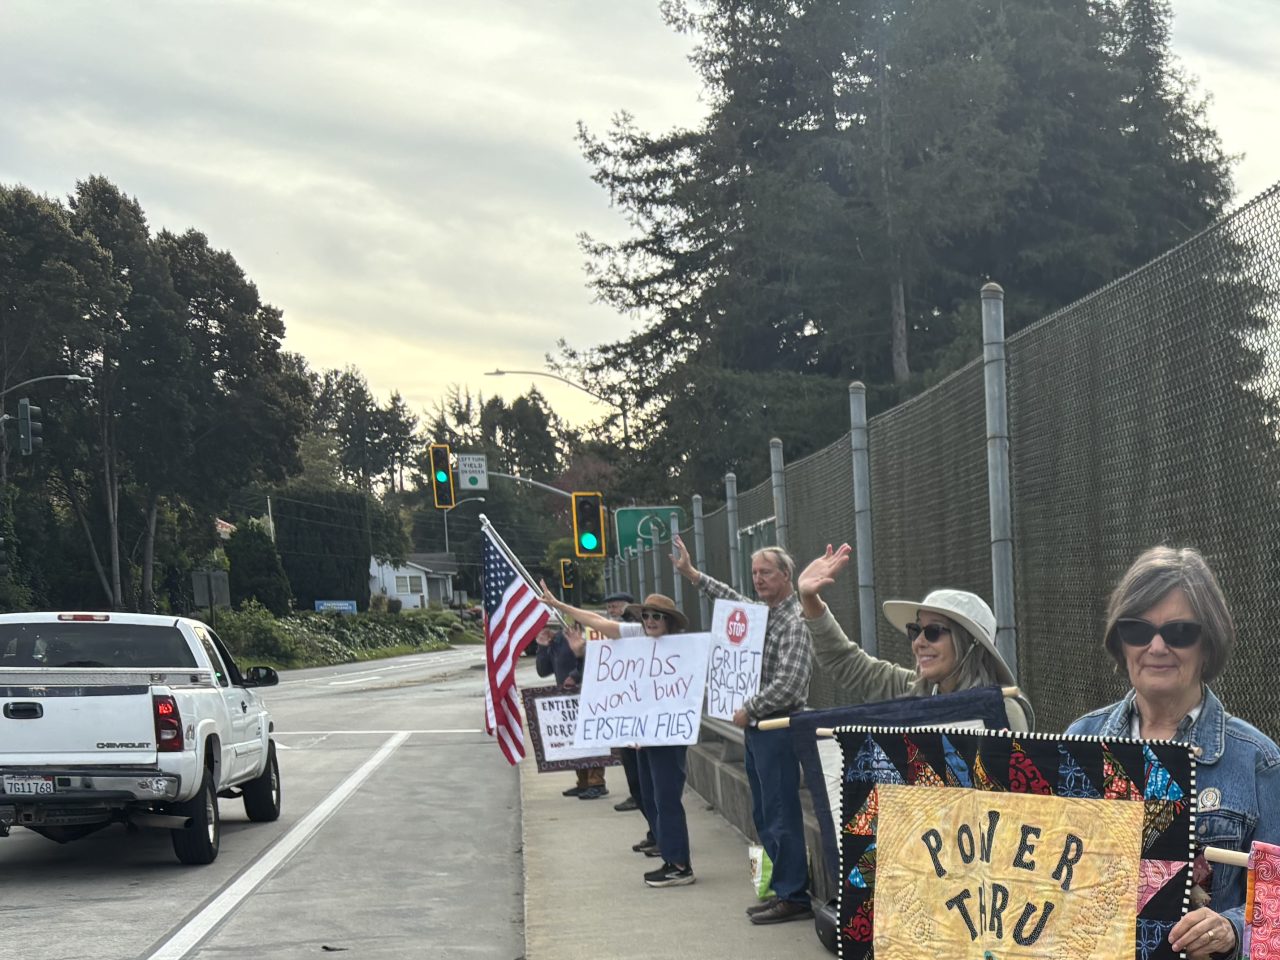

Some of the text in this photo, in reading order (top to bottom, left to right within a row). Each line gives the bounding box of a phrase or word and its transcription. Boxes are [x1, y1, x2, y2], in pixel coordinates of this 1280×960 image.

[728, 622, 746, 637] STOP
[597, 641, 681, 682] Bombs
[711, 645, 762, 674] GRIFT
[588, 674, 693, 716] won't bury
[710, 668, 759, 697] RACISM
[546, 723, 577, 738] DERE
[583, 709, 696, 741] EPSTEIN FILES
[7, 782, 52, 794] 7G11768
[921, 811, 1083, 891] POWER
[946, 883, 1054, 947] THRU
